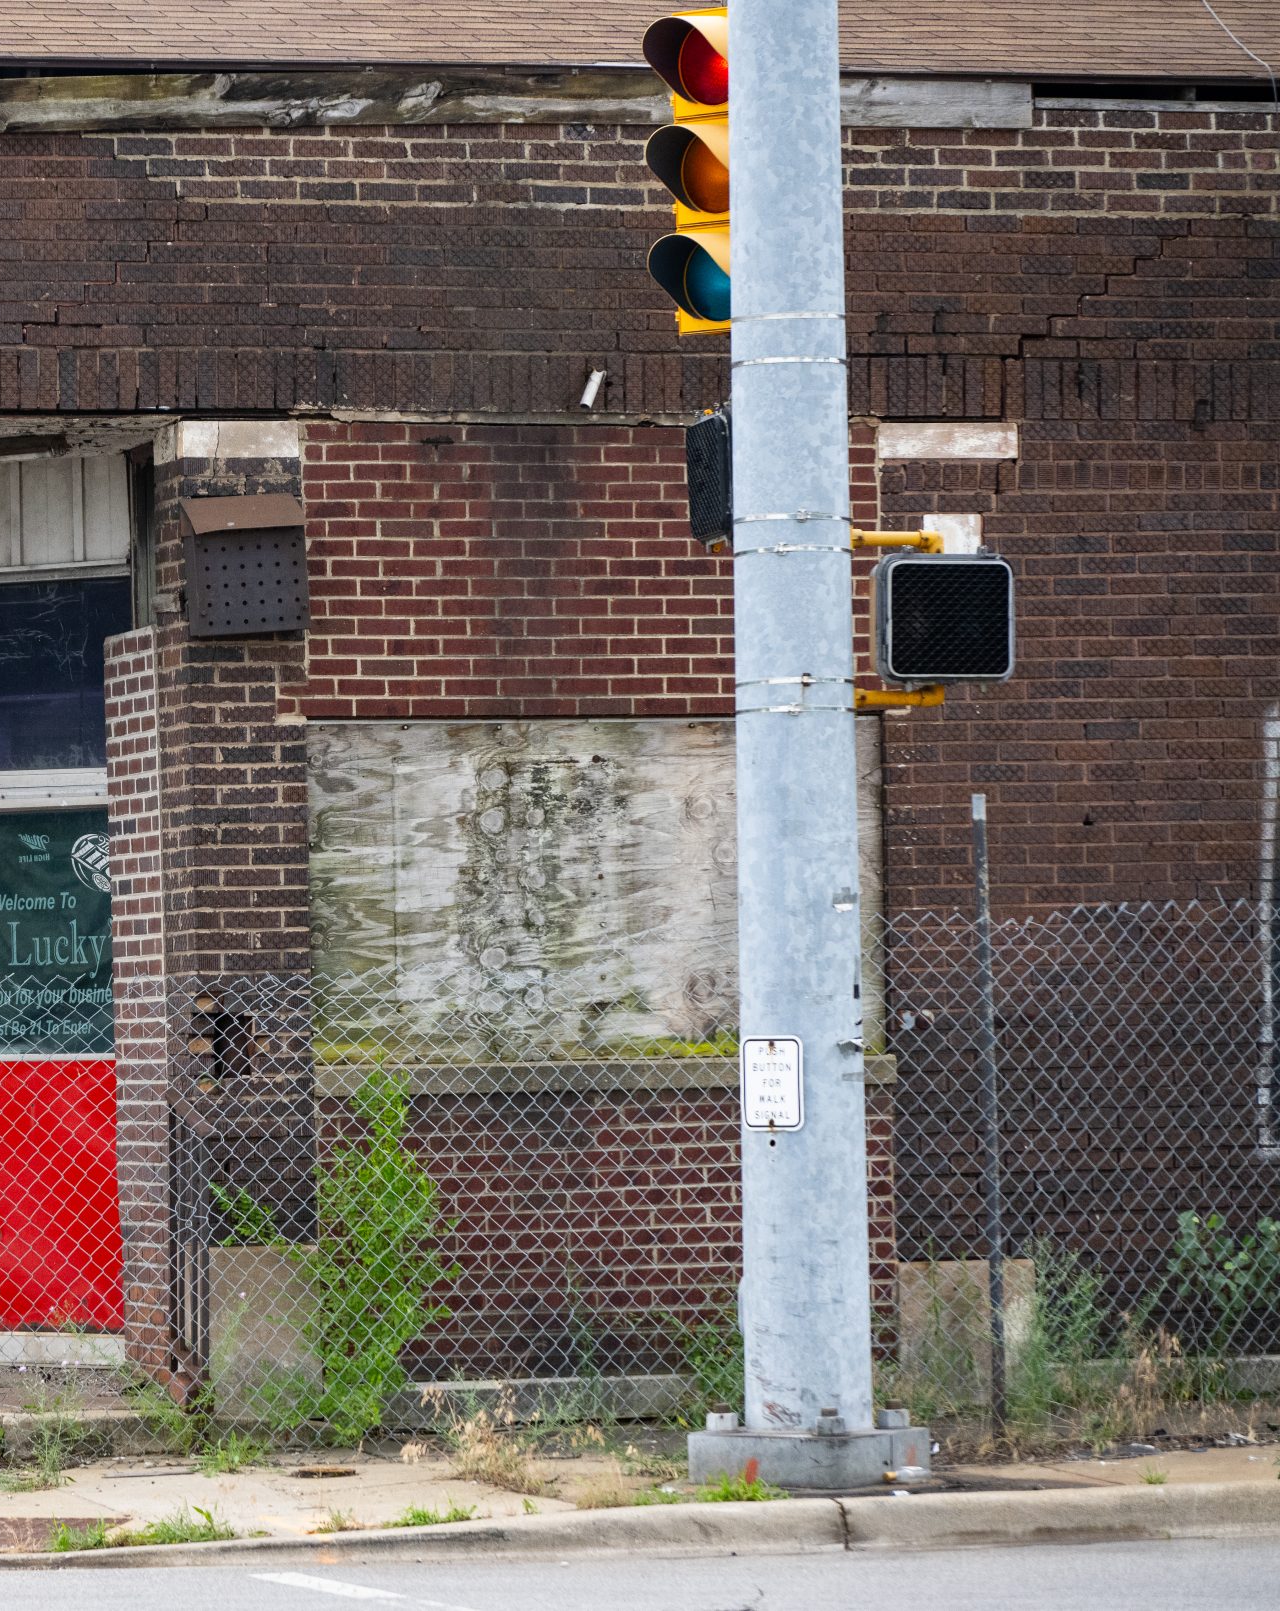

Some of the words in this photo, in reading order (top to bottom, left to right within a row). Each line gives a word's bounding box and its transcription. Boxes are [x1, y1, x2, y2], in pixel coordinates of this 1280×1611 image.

[60, 892, 77, 909] To
[7, 918, 112, 979] Lucky'
[15, 987, 34, 1004] for
[37, 988, 67, 1009] your
[69, 983, 113, 1003] busine
[11, 1020, 26, 1035] Be
[29, 1020, 42, 1035] 21
[46, 1020, 59, 1035] To
[63, 1019, 94, 1035] Enter
[759, 1046, 785, 1056] PUSH
[752, 1062, 792, 1072] BUTTON
[762, 1078, 782, 1088] FOR
[759, 1095, 785, 1104] WALK
[754, 1110, 791, 1120] SIGNAL
